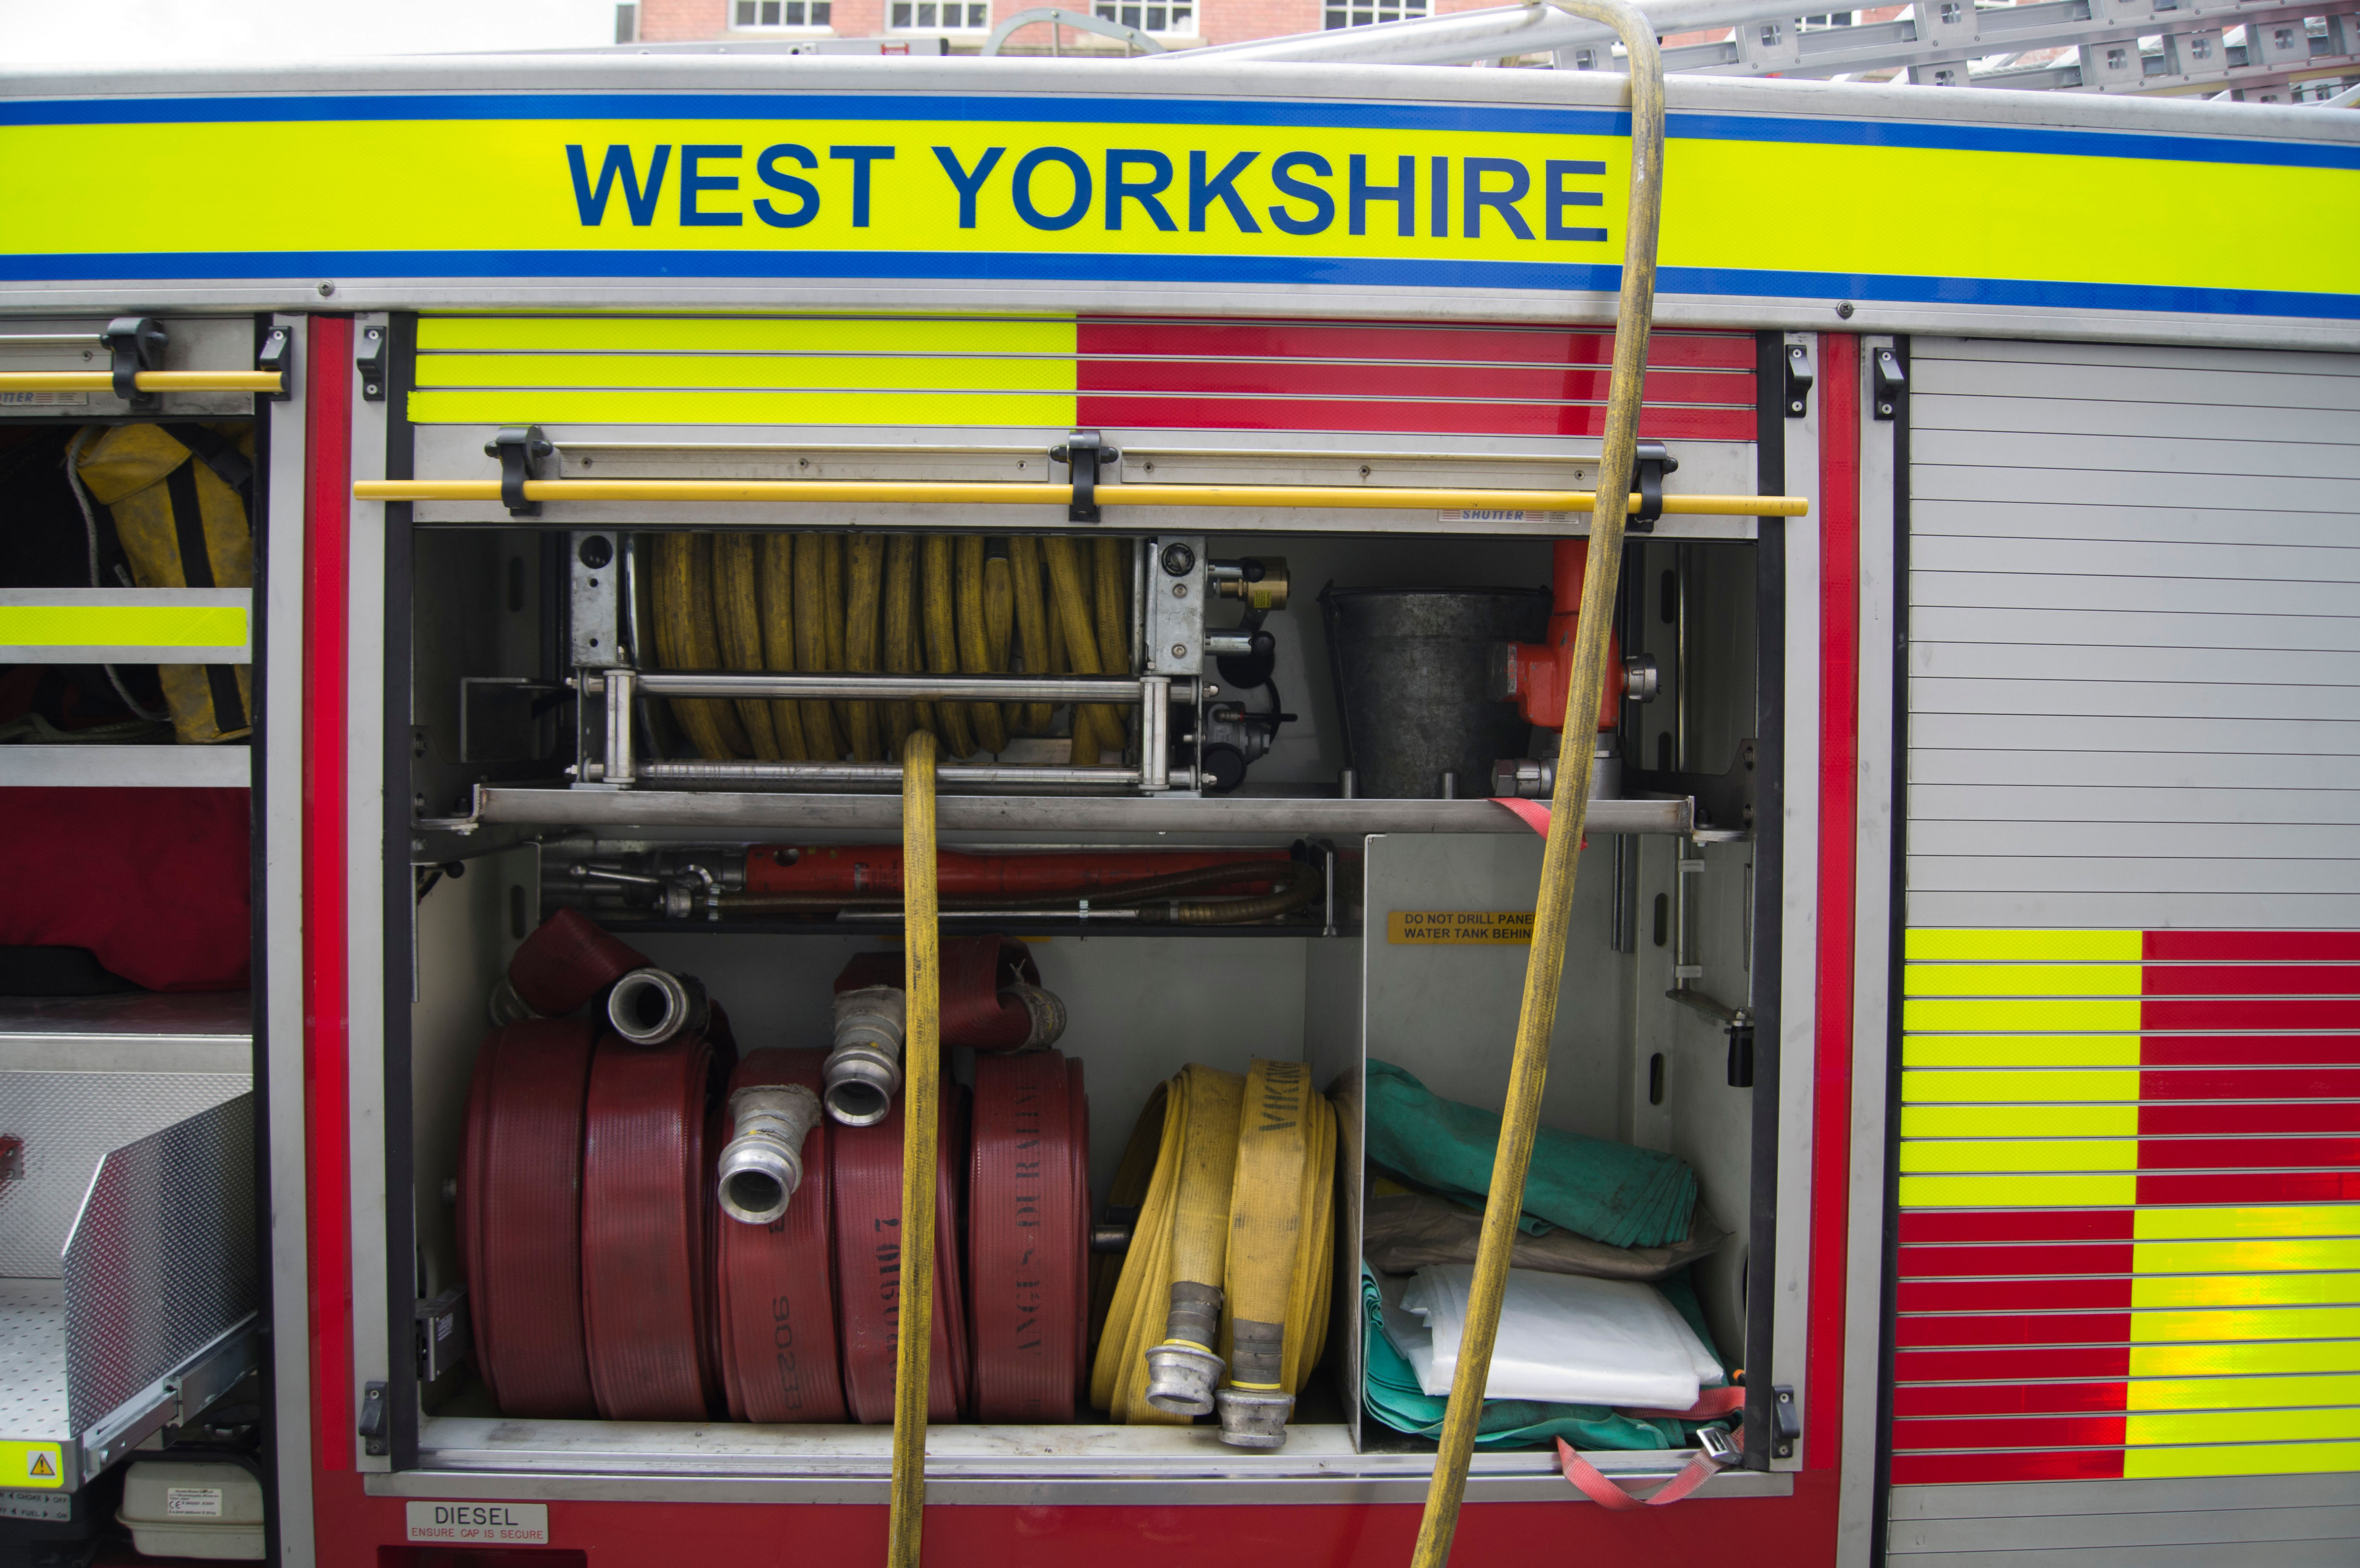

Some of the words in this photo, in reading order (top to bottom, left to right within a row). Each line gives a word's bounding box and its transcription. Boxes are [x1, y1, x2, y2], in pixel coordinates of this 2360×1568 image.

[565, 144, 895, 228] WEST
[931, 146, 1609, 243] YORKSHIRE
[0, 392, 34, 403] TTER
[1462, 510, 1524, 520] SHUTTER
[1405, 914, 1423, 924] DO
[1427, 914, 1453, 924] NOT
[1458, 914, 1494, 924] DRILL
[1499, 914, 1536, 924] PANE
[1404, 929, 1450, 938] WATER
[1454, 929, 1488, 938] TANK
[1493, 929, 1533, 939] BEHIN
[1258, 1061, 1300, 1132] VIKING
[773, 1295, 802, 1409] 90233
[17, 1493, 42, 1501] CHOKE
[435, 1507, 518, 1526] DIESEL
[412, 1528, 455, 1537] ENSURE
[461, 1529, 479, 1537] CAP
[484, 1530, 494, 1538] IS
[500, 1530, 543, 1540] SECURE
